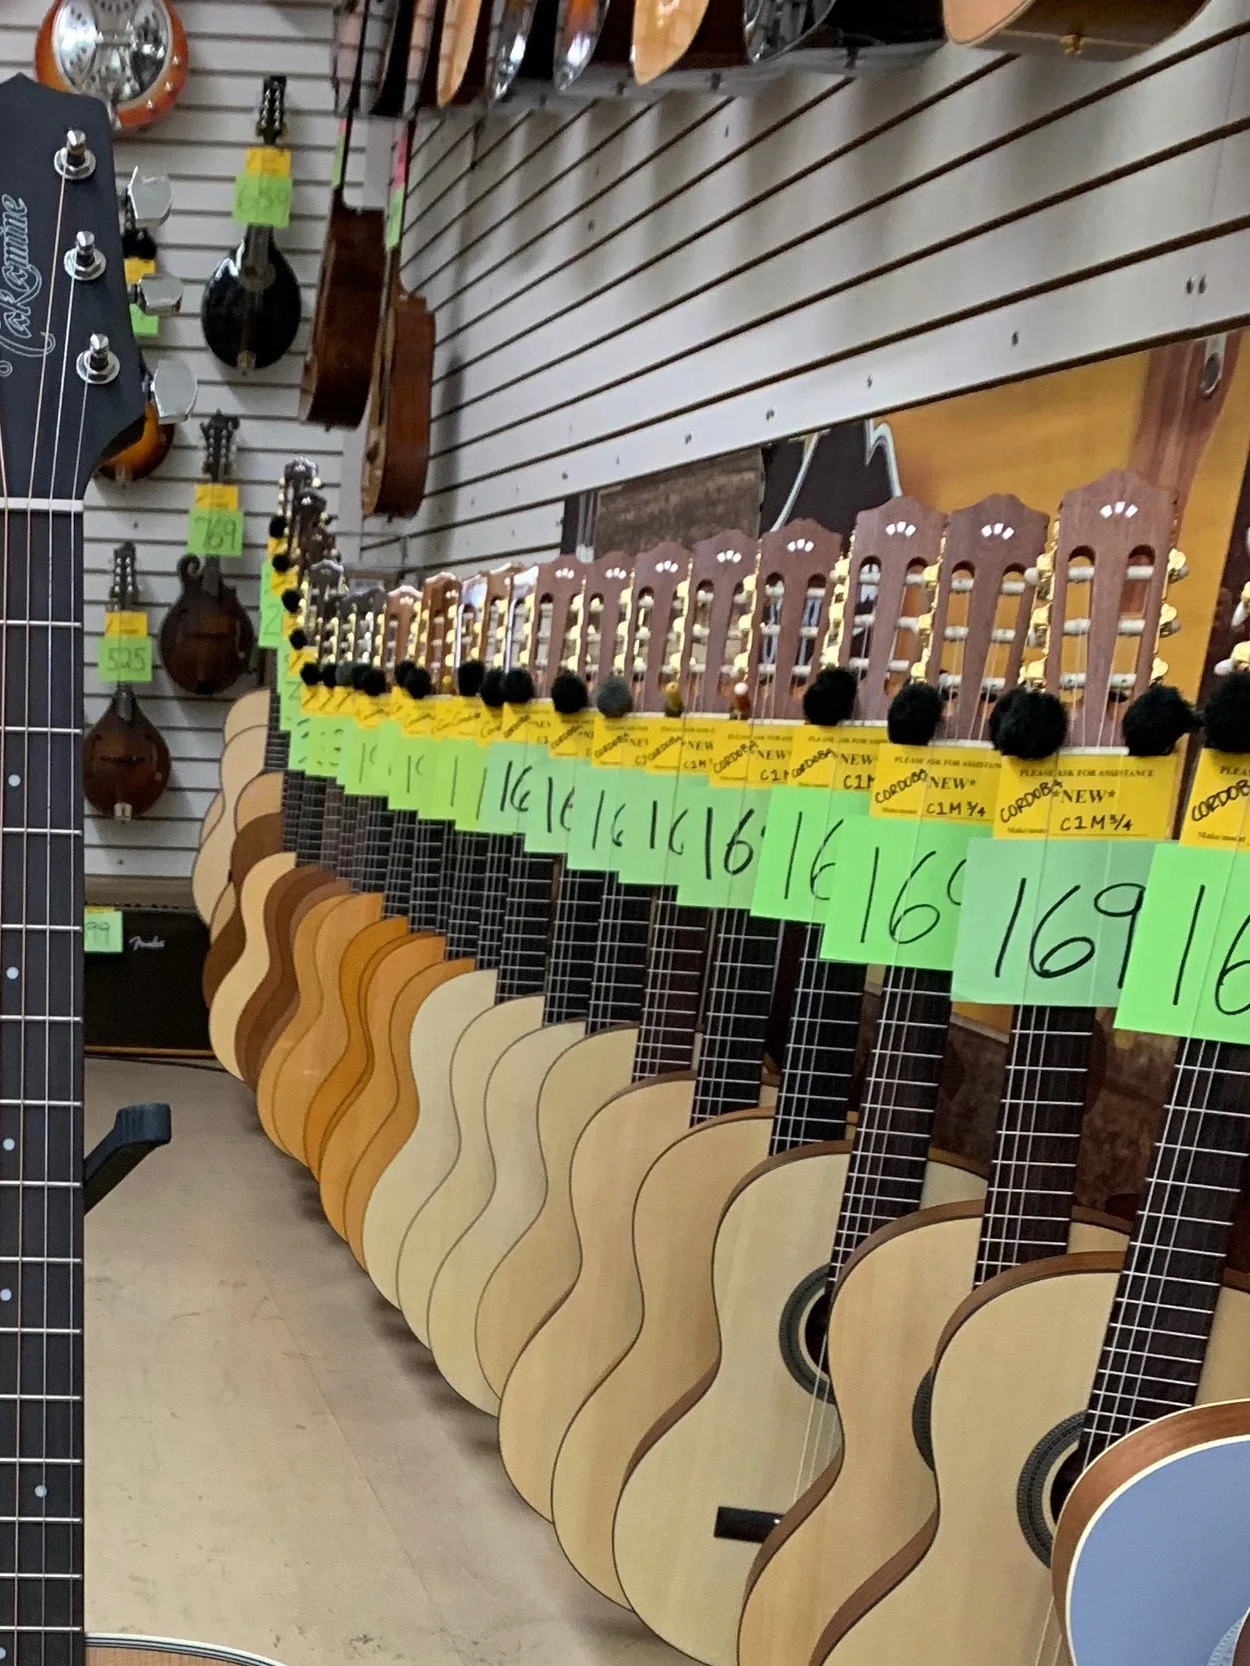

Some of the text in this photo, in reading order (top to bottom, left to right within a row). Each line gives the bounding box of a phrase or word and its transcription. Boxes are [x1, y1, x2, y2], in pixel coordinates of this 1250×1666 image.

[106, 646, 148, 673] 525
[712, 740, 759, 774] CORDOBA
[790, 747, 835, 780] CORDOBA
[1019, 768, 1052, 777] PLEASE
[1077, 769, 1098, 777] FOR
[1099, 768, 1155, 777] ASSISTANCE
[874, 768, 928, 804] CORDOBA
[999, 778, 1063, 824] CORDOBA
[1060, 814, 1107, 832] C1M
[705, 806, 766, 881] 16
[994, 877, 1147, 990] 169
